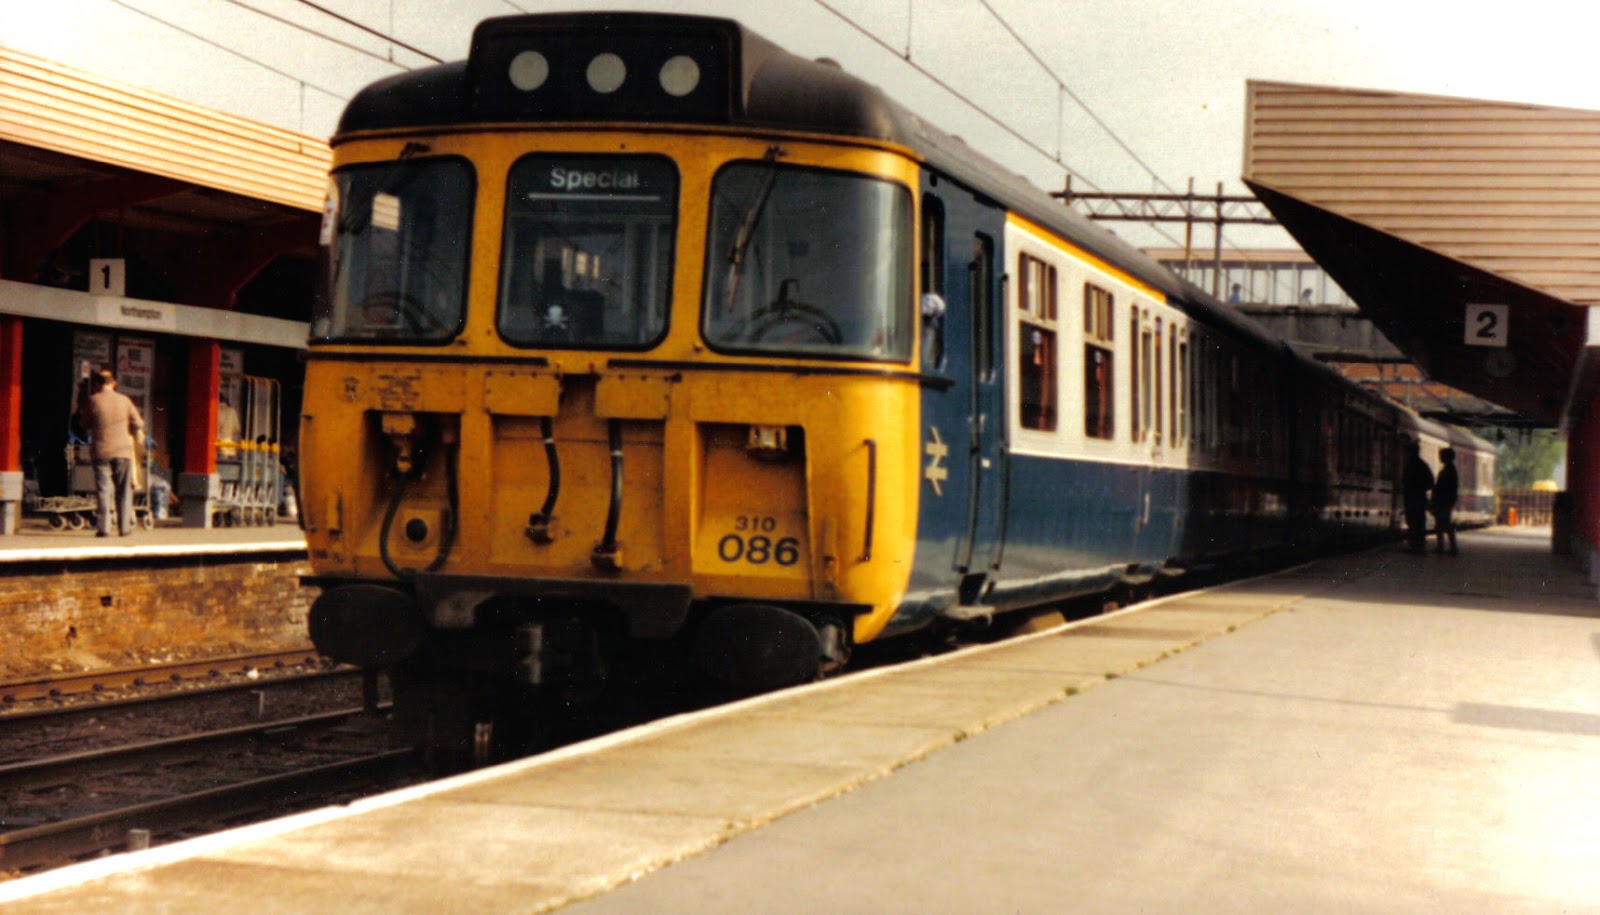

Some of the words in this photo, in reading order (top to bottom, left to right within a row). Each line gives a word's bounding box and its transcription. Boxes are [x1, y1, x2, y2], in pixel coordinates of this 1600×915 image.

[551, 167, 640, 190] Special
[101, 265, 110, 289] 1
[1476, 311, 1497, 338] 2
[735, 515, 776, 532] 310
[718, 534, 799, 566] 086
